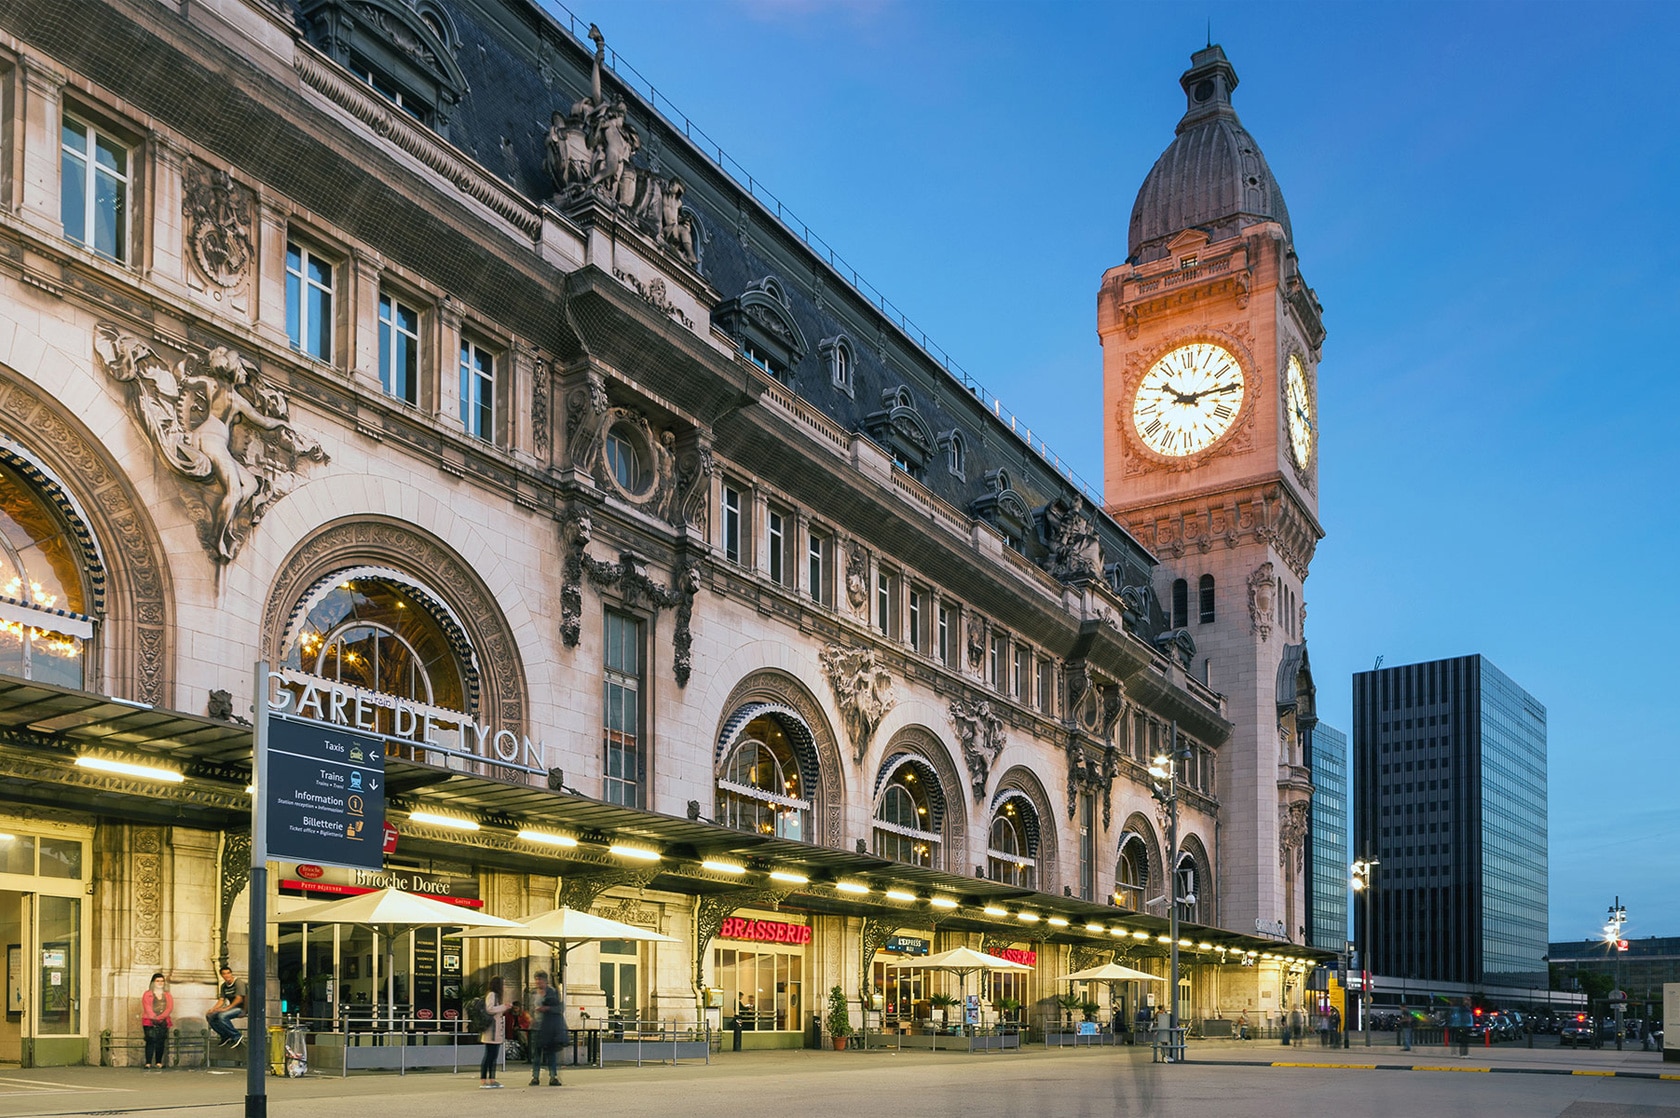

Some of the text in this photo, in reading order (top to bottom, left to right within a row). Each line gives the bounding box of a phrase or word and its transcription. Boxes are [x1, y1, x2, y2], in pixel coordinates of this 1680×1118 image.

[267, 671, 546, 771] GARE DE LYON
[324, 740, 345, 753] Taxis
[320, 769, 344, 783] Trains
[294, 789, 344, 807] Information
[294, 801, 314, 809] reception
[303, 816, 344, 831] Billetterie
[383, 828, 398, 847] F
[355, 869, 451, 895] Brioche Dorée
[720, 917, 812, 944] BRASSERIE
